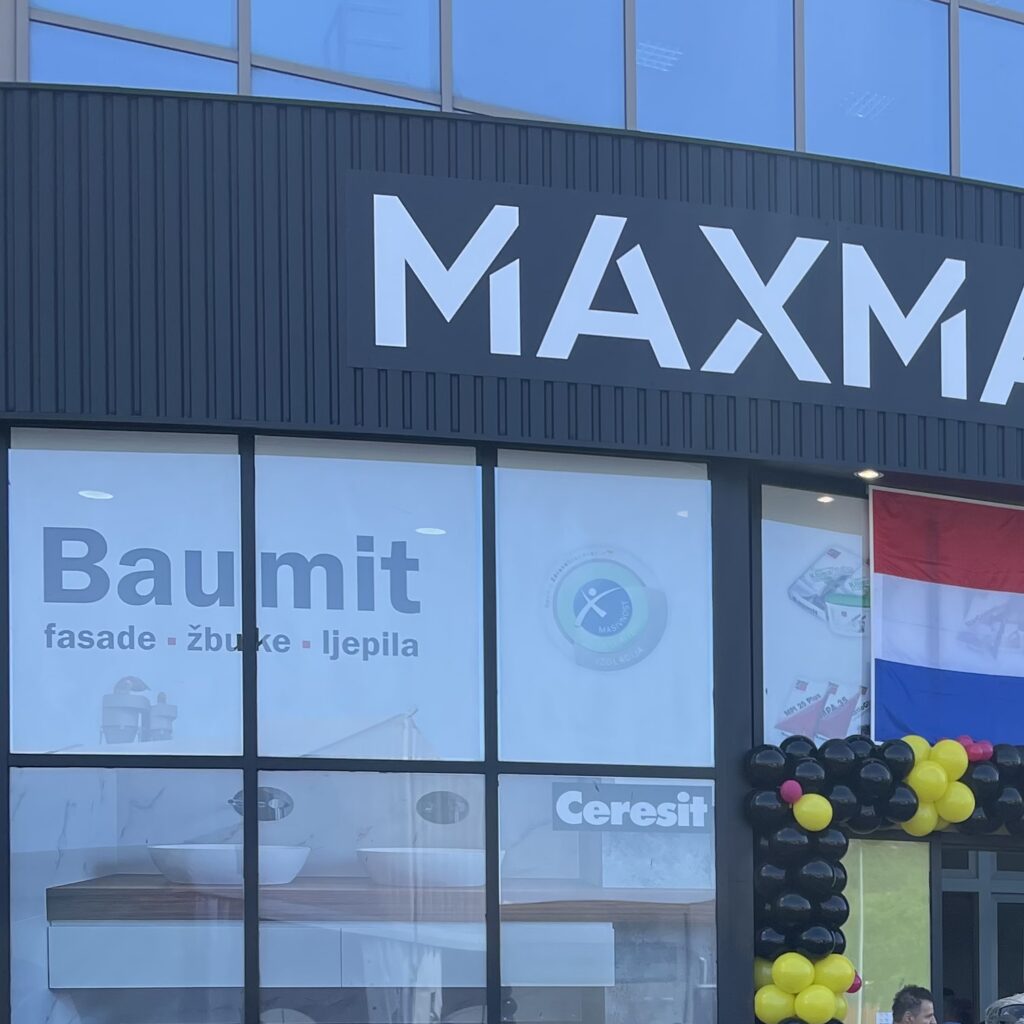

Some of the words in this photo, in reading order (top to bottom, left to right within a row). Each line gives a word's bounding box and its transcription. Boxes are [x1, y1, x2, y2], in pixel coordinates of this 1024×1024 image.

[43, 526, 421, 613] Baumit
[44, 623, 156, 651] fasade
[322, 629, 419, 661] ljepila
[556, 790, 708, 827] Ceresit
